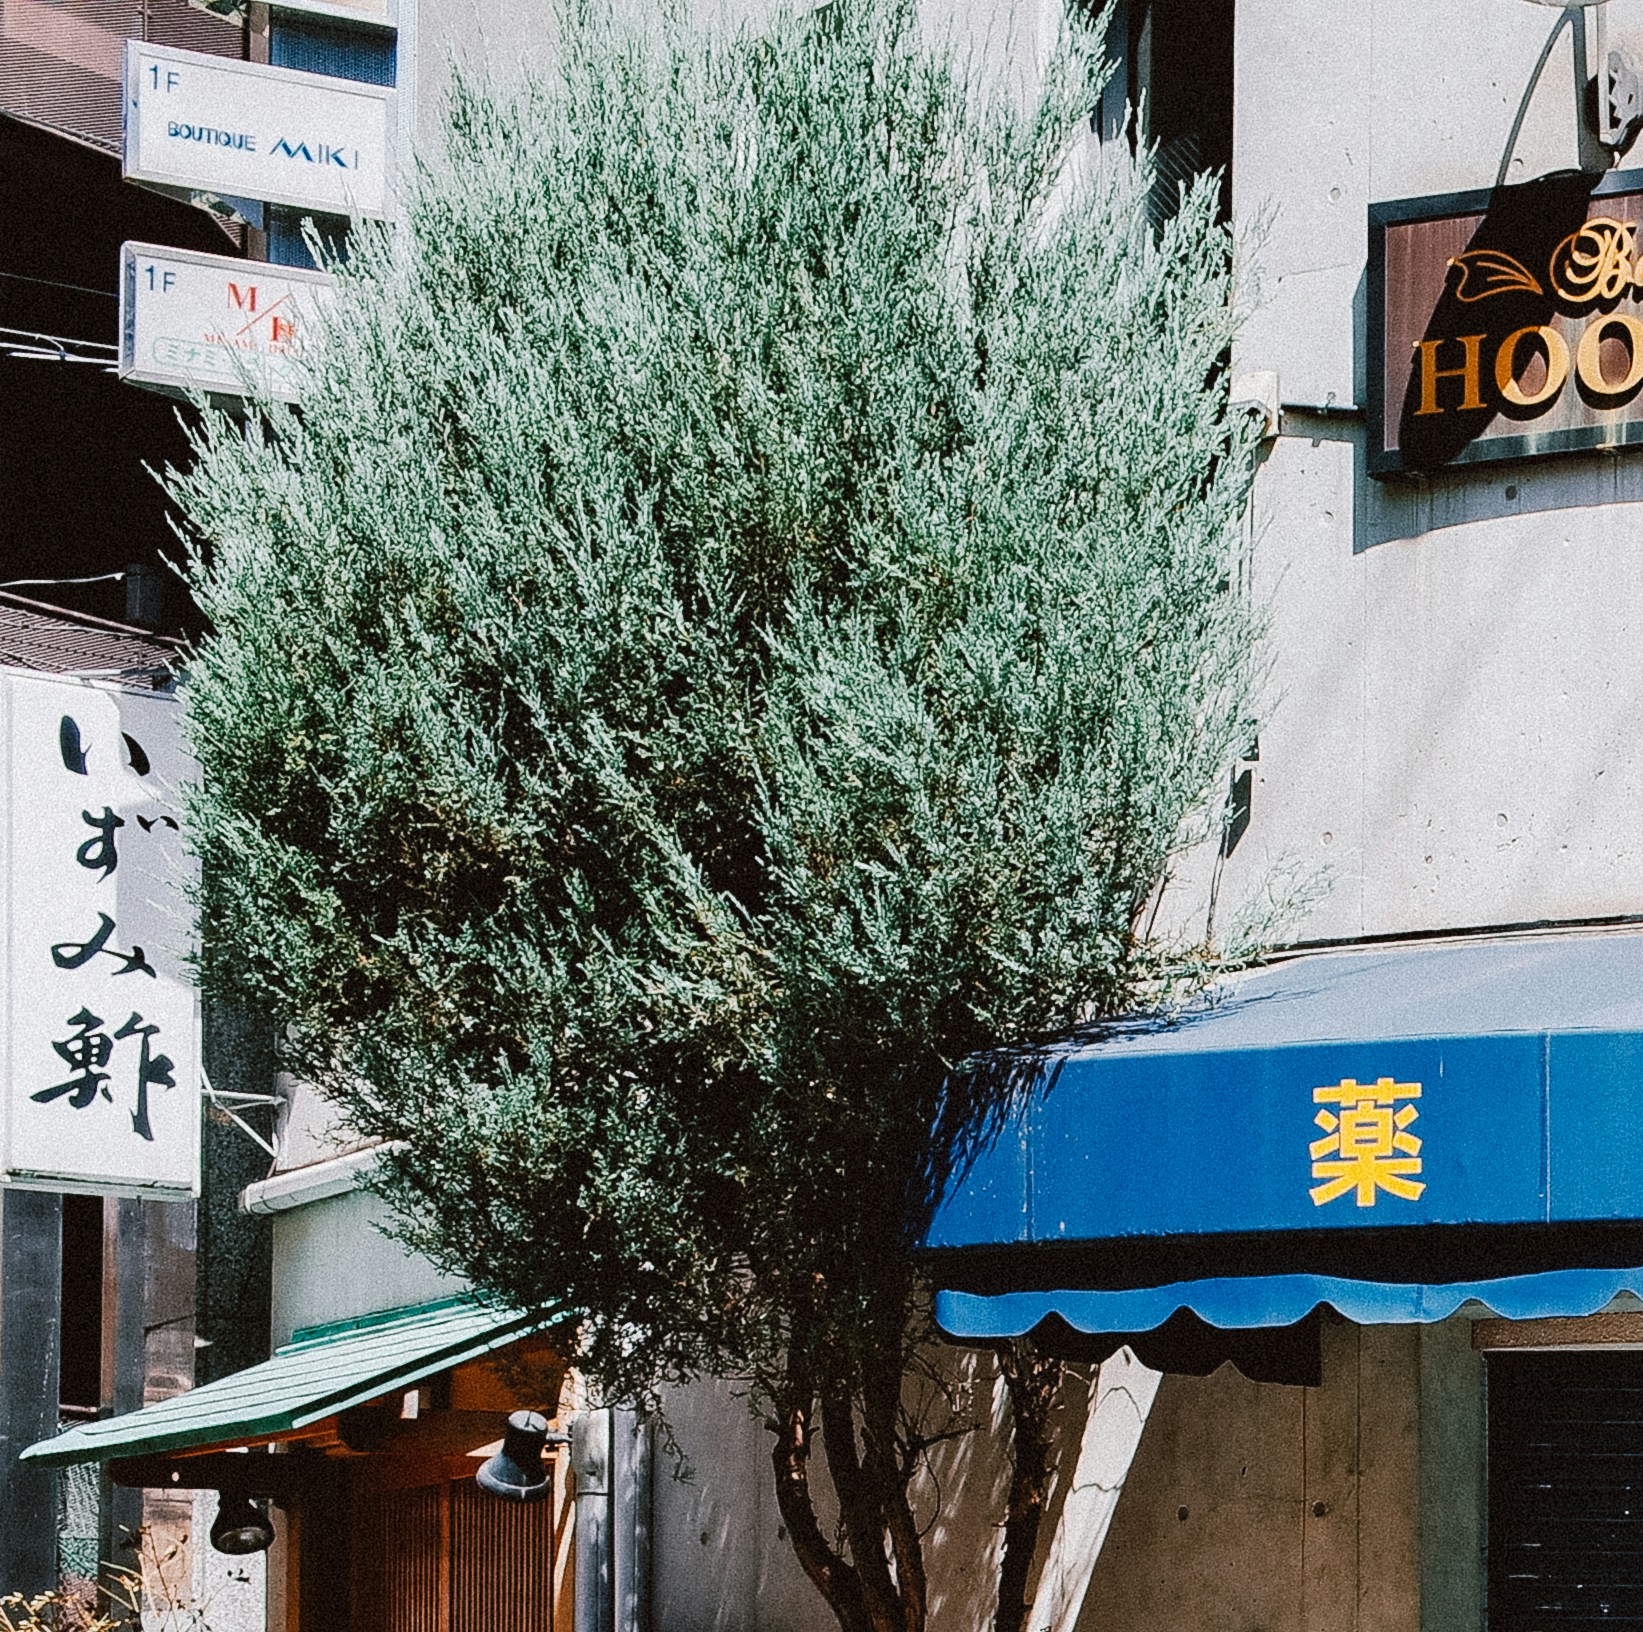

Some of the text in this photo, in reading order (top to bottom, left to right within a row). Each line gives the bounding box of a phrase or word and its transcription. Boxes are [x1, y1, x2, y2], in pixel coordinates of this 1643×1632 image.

[148, 65, 180, 93] 1F
[167, 120, 359, 170] BOUTIQUE MIKI
[145, 265, 176, 292] 1F
[1308, 1077, 1427, 1207] 薬
